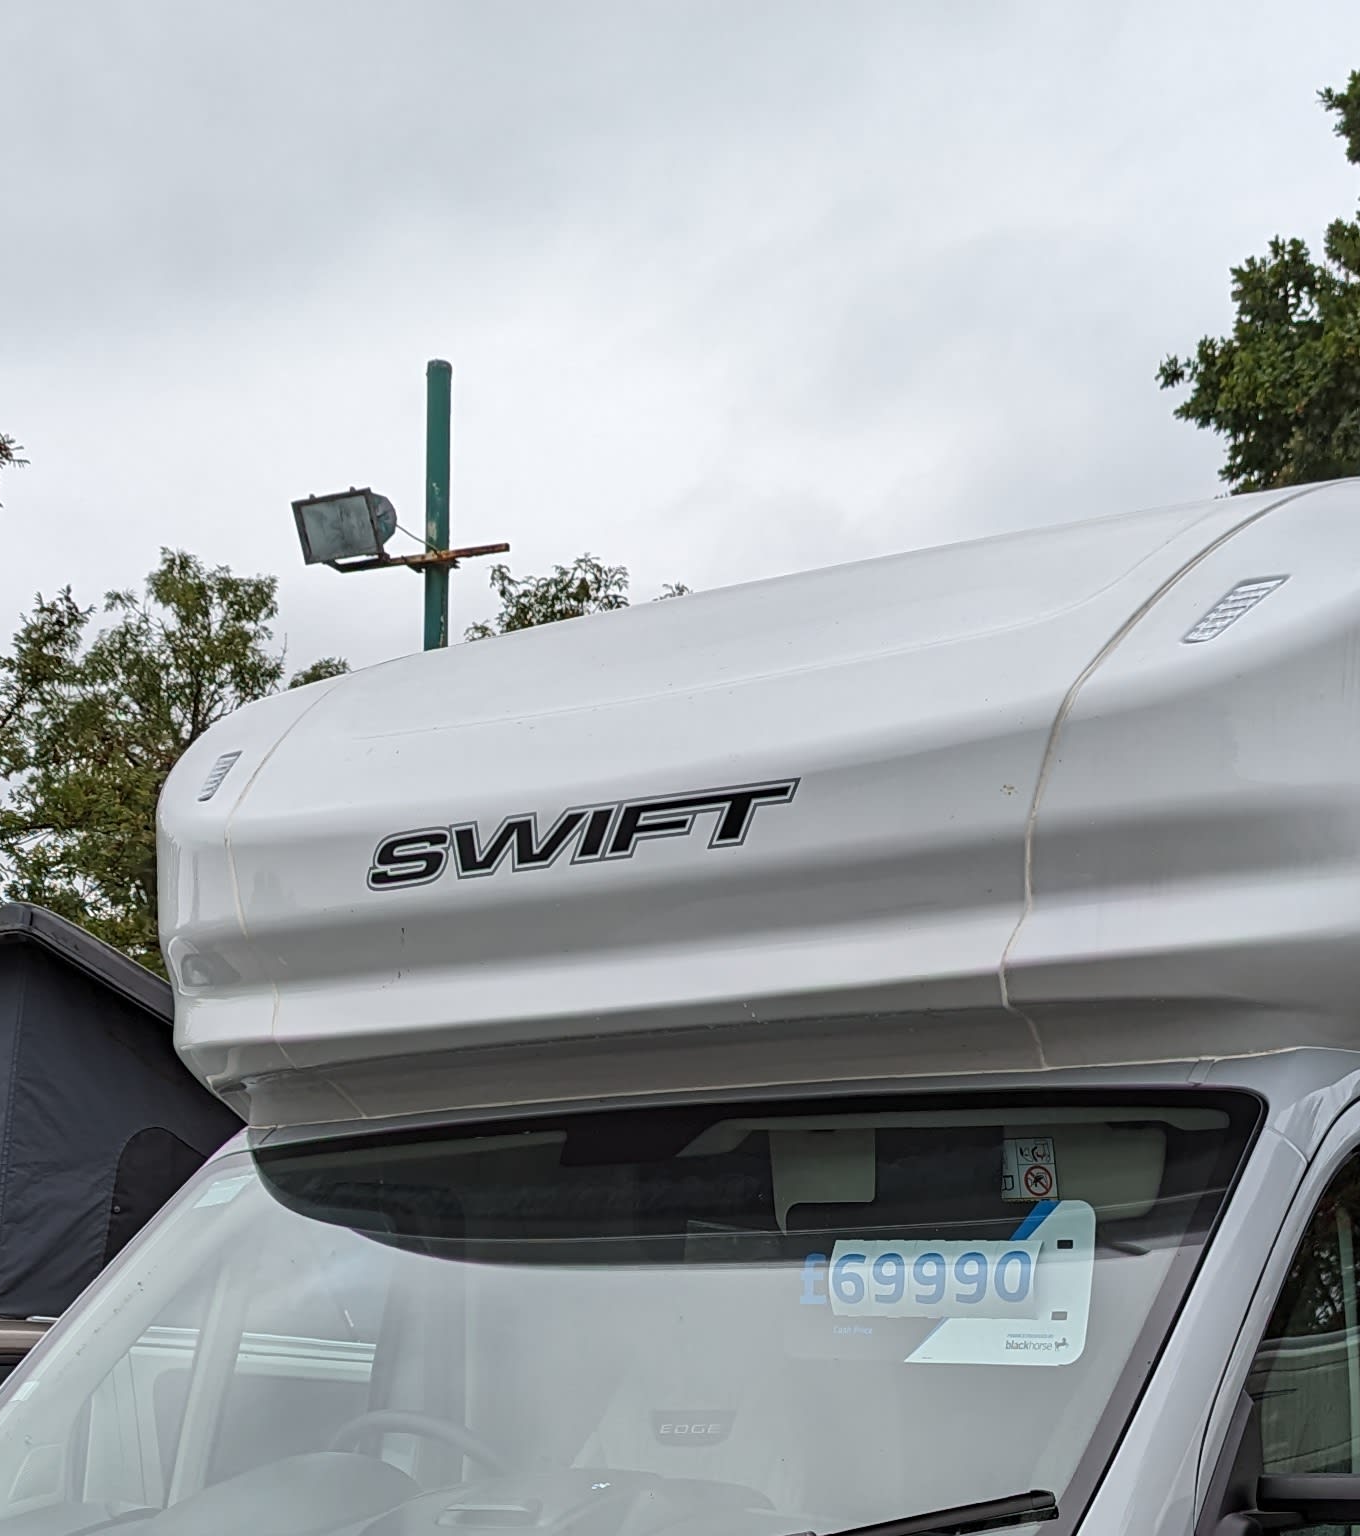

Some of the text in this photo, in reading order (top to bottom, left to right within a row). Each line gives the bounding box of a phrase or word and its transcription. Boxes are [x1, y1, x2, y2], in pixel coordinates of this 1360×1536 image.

[367, 777, 801, 891] SWIFT
[800, 1250, 1031, 1304] £69990
[833, 1325, 873, 1336] Cash Price
[1005, 1340, 1052, 1350] blackhorse
[659, 1423, 721, 1434] EDGE
